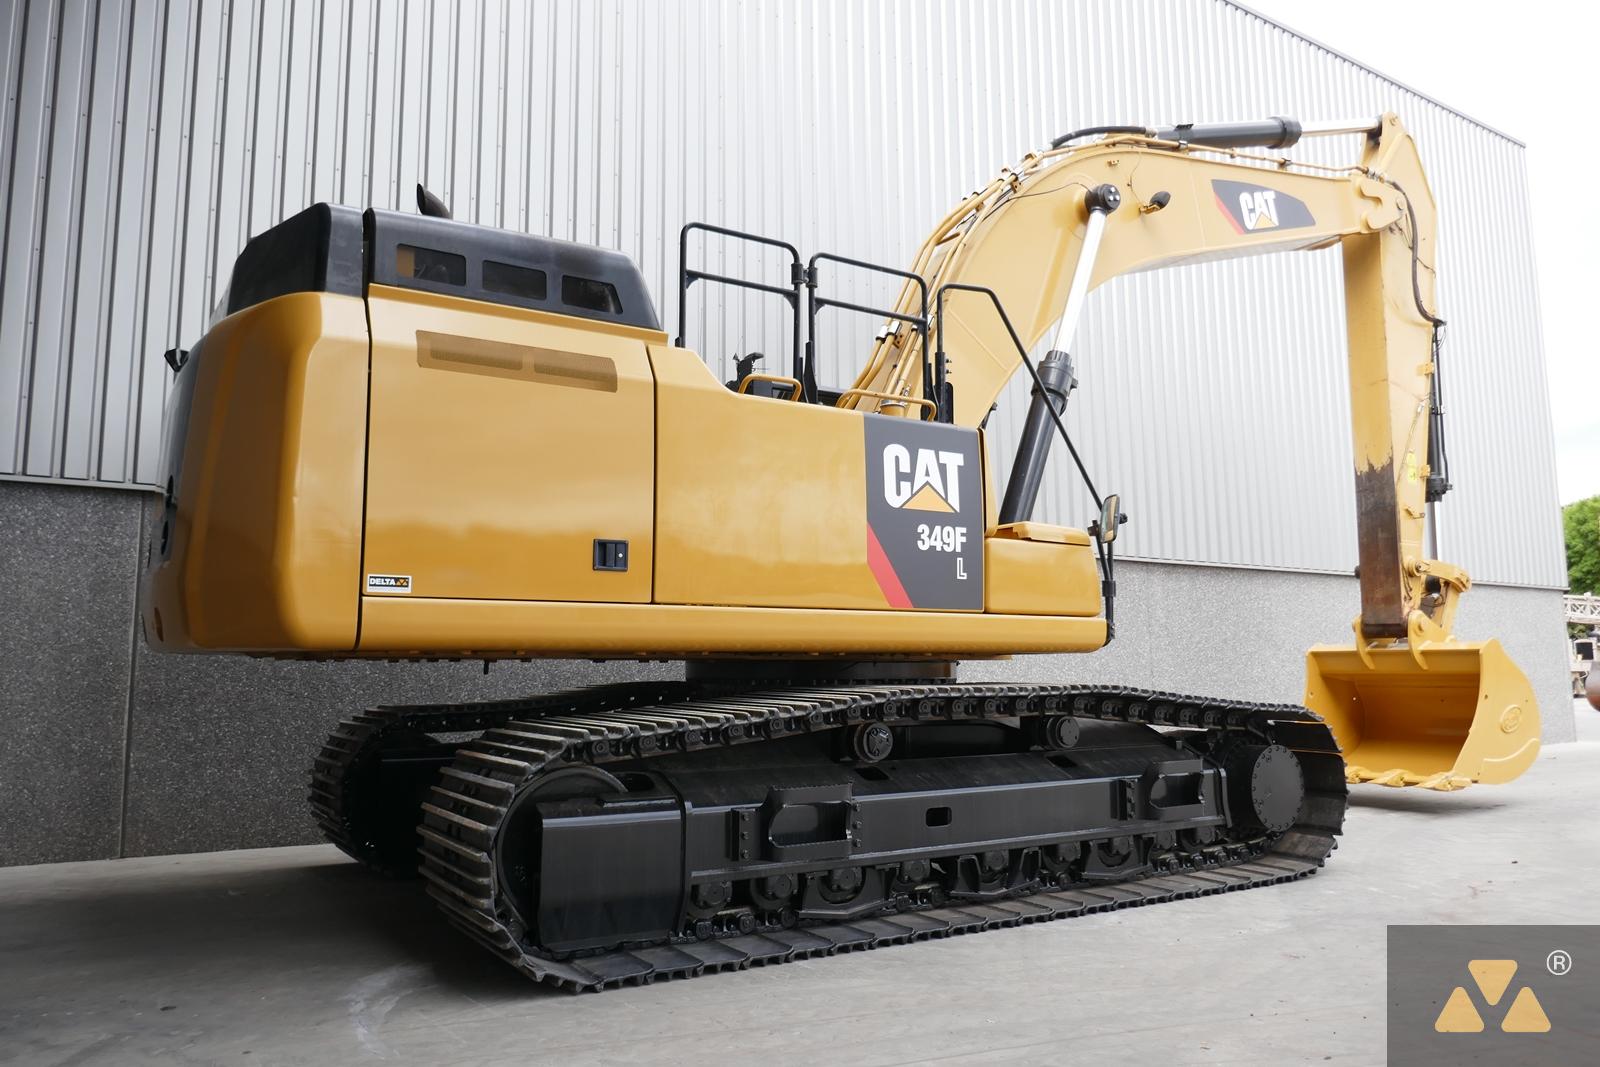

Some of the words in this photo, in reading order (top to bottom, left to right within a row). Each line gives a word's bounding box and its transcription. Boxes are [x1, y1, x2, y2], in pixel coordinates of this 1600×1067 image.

[1239, 191, 1279, 230] CAT
[883, 443, 964, 513] CAT
[917, 524, 967, 552] 349F
[369, 577, 396, 586] DELTA
[956, 557, 967, 580] L
